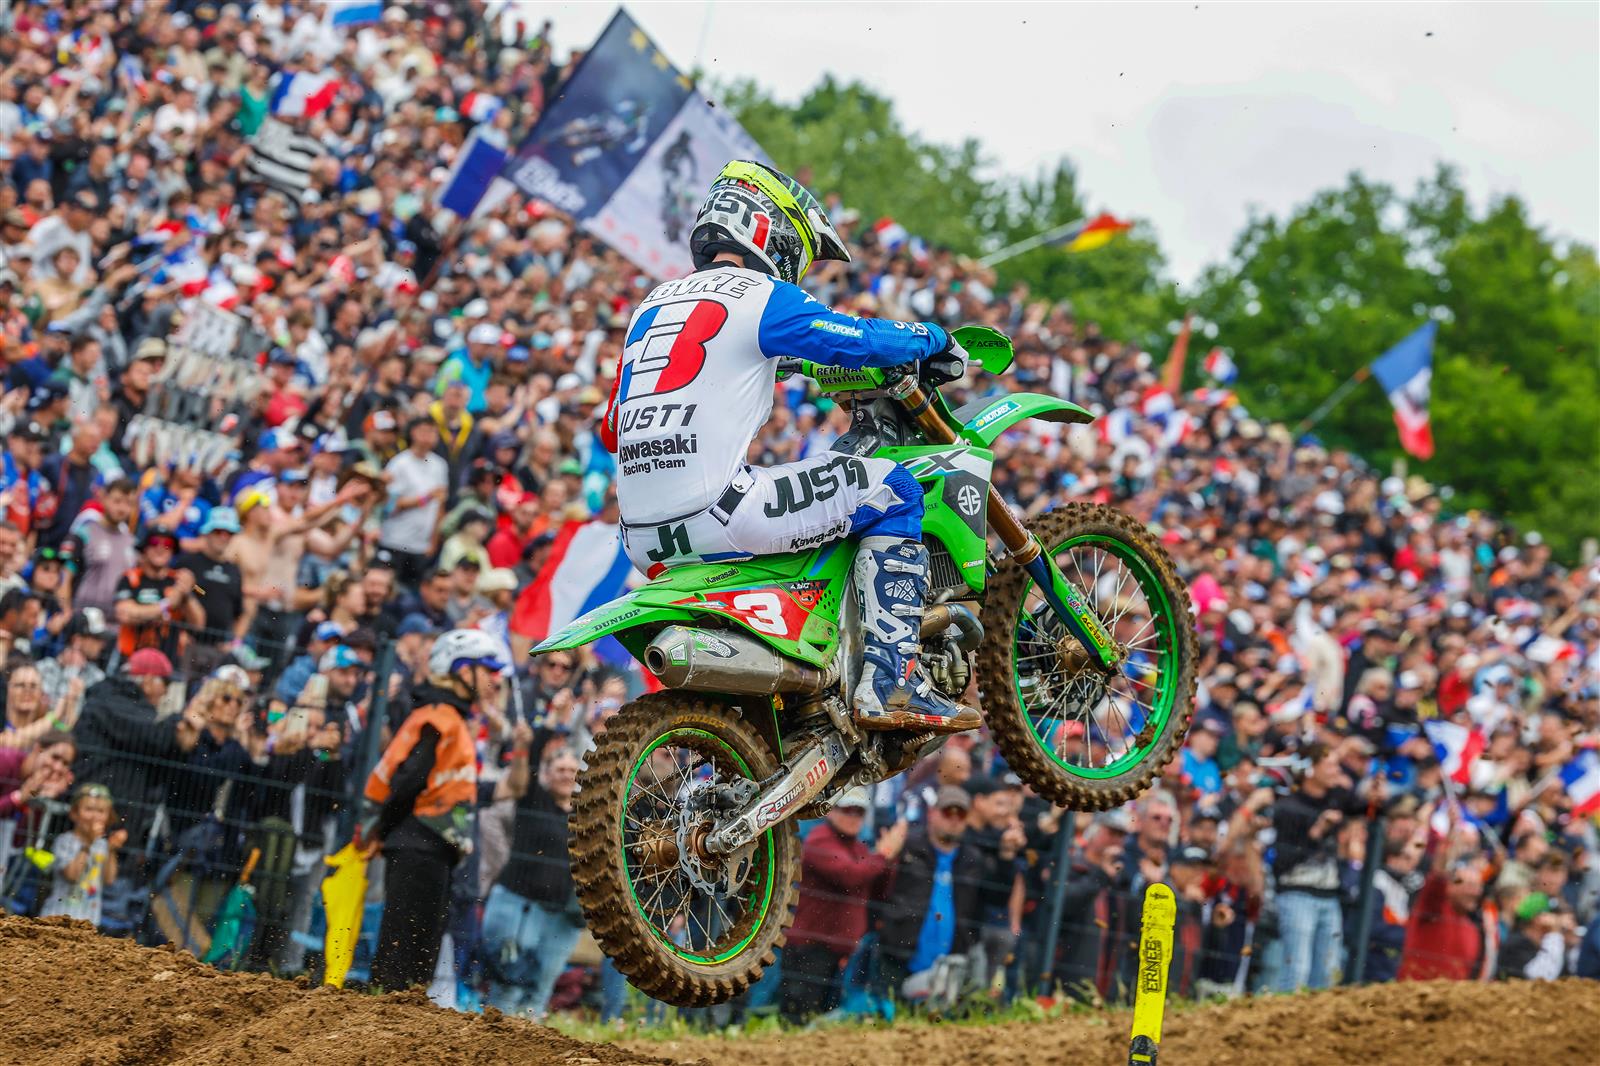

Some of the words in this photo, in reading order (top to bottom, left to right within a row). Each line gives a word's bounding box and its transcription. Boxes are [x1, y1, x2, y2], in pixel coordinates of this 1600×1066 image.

[620, 298, 728, 405] 3
[816, 366, 865, 377] RENTHAL
[820, 373, 870, 385] RENTHAL
[983, 402, 1012, 424] MOTOREX
[619, 433, 698, 465] Kawasaki
[623, 461, 651, 477] Racing
[651, 458, 686, 471] Team
[763, 456, 870, 518] JUST1
[704, 567, 740, 585] Kawasaki
[593, 608, 641, 632] DUNLOP
[734, 593, 788, 636] 3
[805, 758, 830, 787] DID
